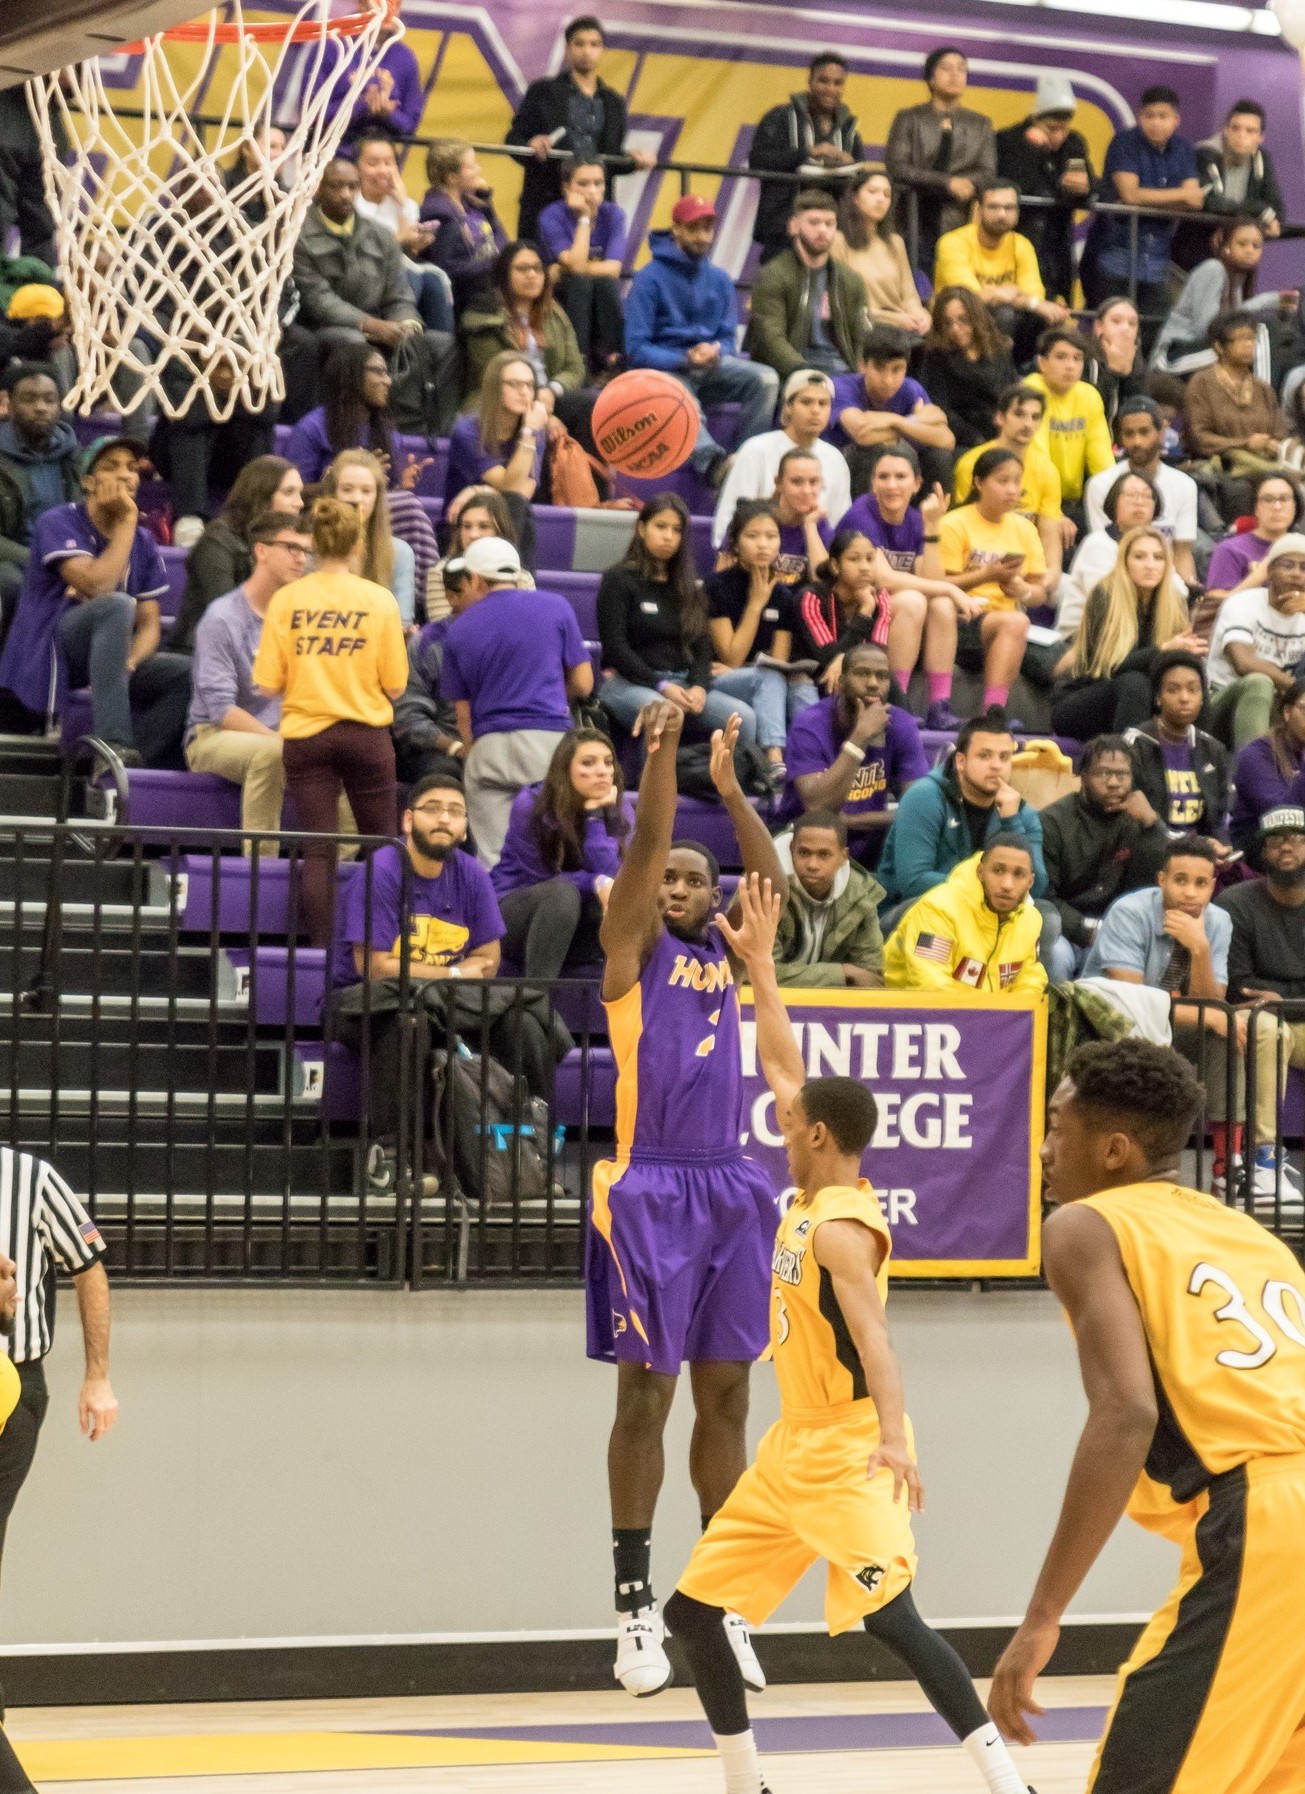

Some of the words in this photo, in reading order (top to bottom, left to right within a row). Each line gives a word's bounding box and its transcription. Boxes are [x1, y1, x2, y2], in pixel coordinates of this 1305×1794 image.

[600, 412, 657, 454] Wilson
[290, 608, 369, 630] EVENT
[295, 635, 368, 656] STAFF
[740, 1021, 967, 1080] NTER
[1187, 1261, 1305, 1370] 30
